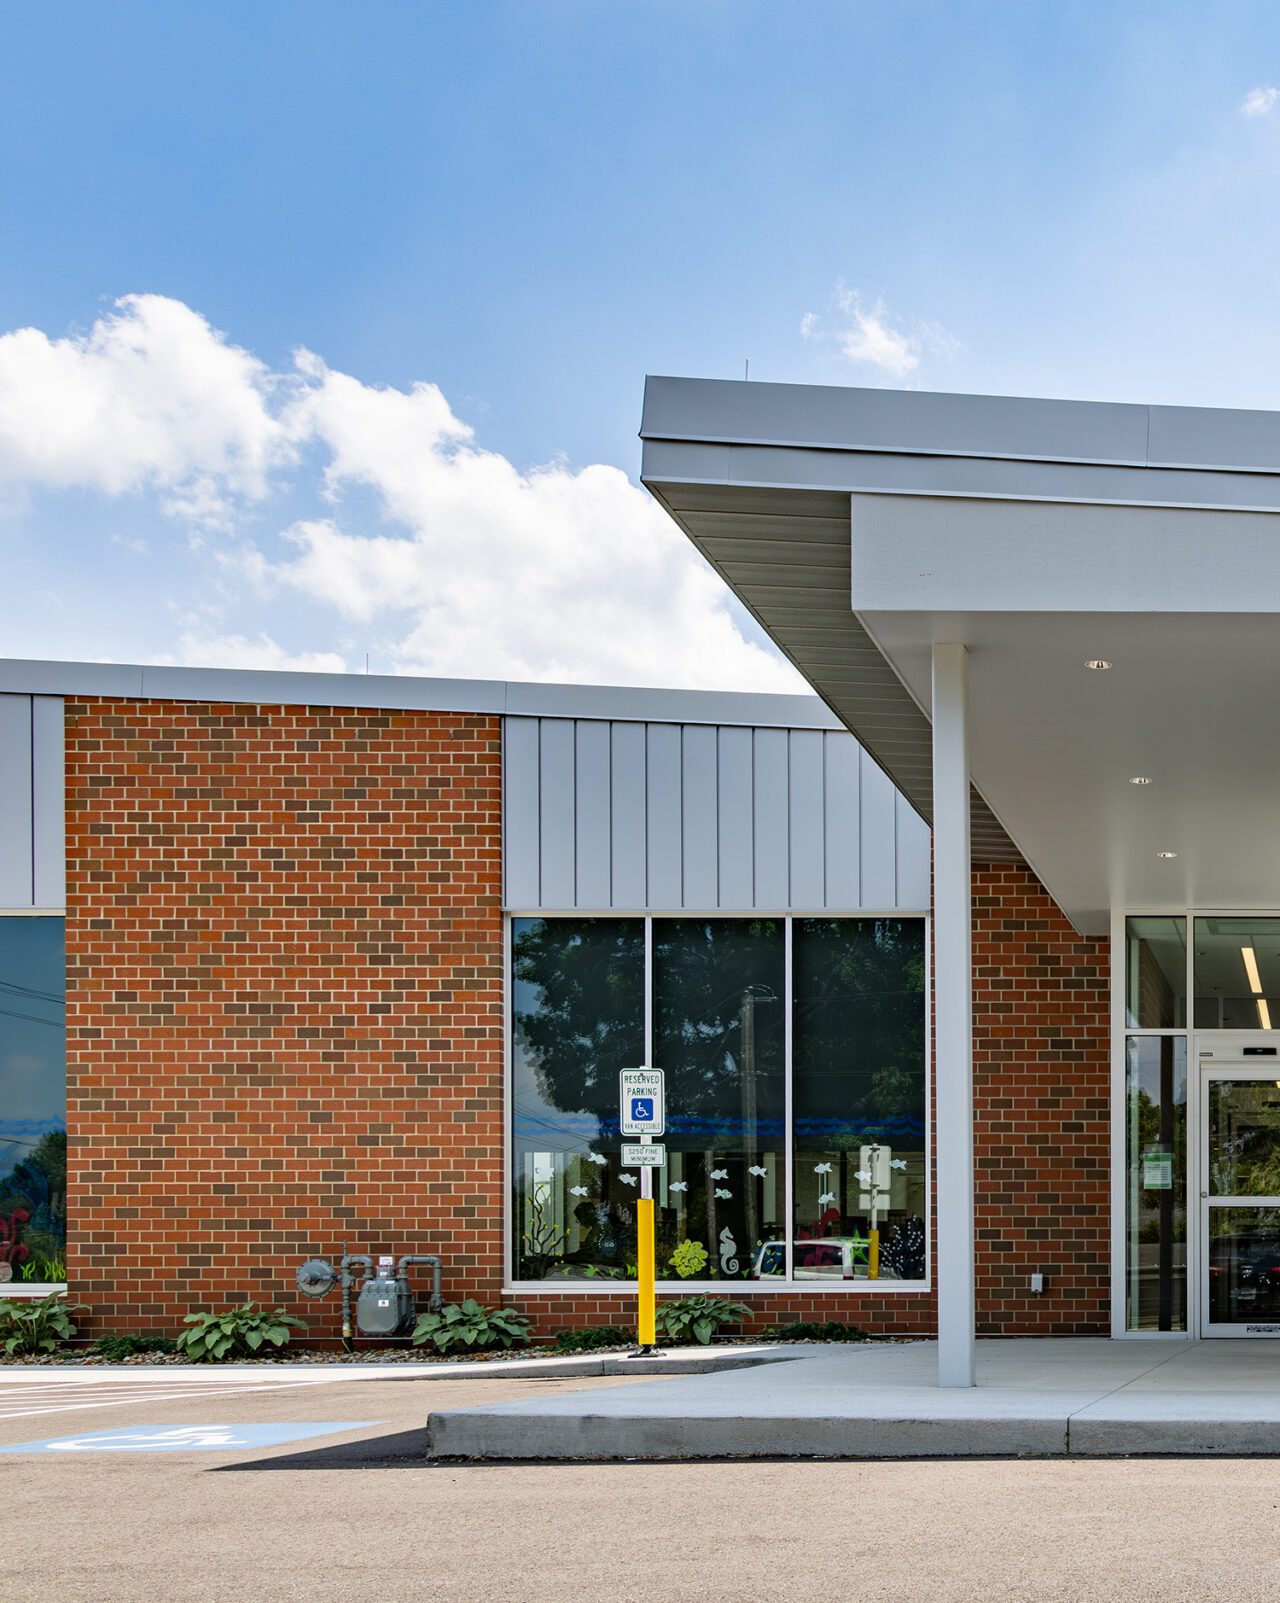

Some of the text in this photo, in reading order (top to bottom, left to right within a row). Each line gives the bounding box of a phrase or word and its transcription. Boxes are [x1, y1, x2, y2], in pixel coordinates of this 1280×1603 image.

[624, 1075, 660, 1084] RESERVED
[627, 1087, 658, 1096] PARKING
[634, 1122, 660, 1130] ACCESSIBLE
